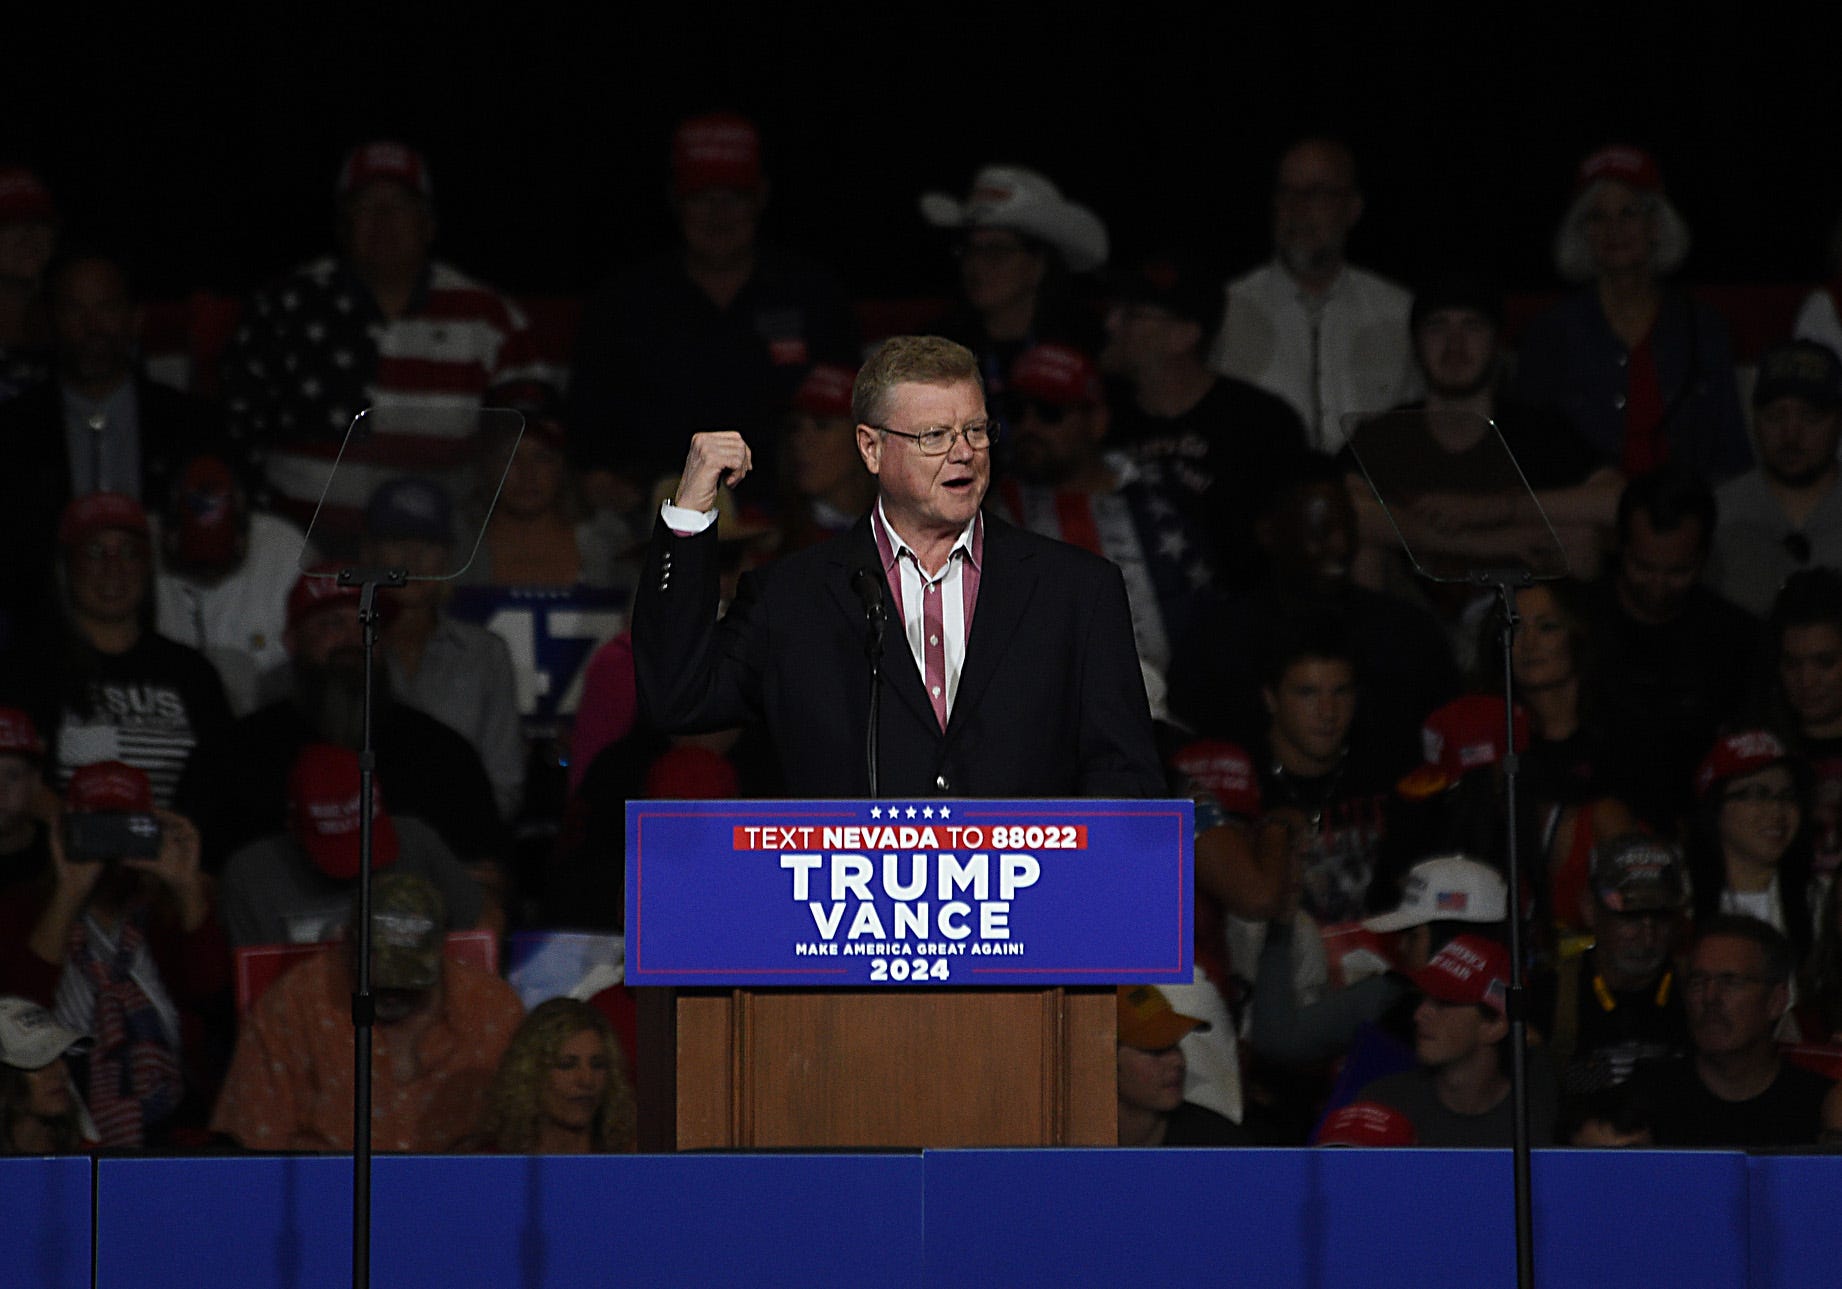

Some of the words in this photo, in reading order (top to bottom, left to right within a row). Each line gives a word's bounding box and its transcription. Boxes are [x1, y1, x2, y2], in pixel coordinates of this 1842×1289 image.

[744, 826, 815, 850] TEXT
[822, 826, 940, 849] NEVADA
[946, 826, 984, 849] TO
[991, 825, 1077, 849] 88022
[780, 853, 1041, 903] TRUMP
[809, 902, 1010, 940] VANCE
[795, 942, 838, 956] MAKE
[843, 942, 912, 956] AMERICA
[916, 942, 967, 956] GREAT
[970, 942, 1024, 956] AGAIN!
[870, 957, 950, 981] 2024
